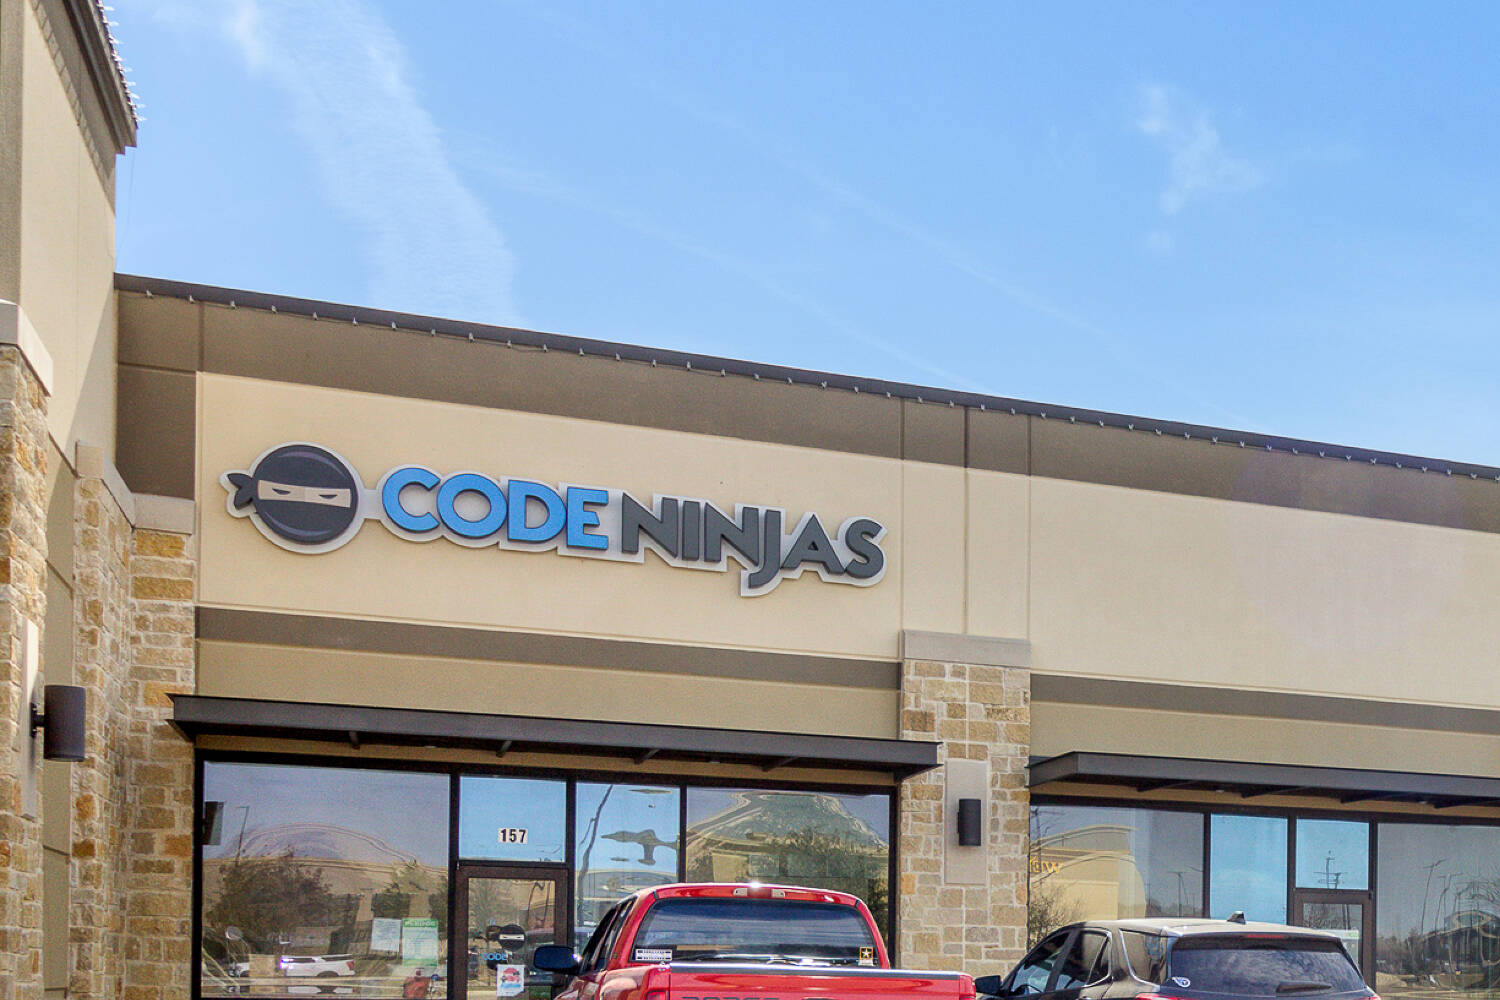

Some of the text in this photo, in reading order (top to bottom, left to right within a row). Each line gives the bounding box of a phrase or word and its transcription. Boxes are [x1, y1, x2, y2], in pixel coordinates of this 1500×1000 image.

[381, 467, 885, 589] CODE NINJAS
[500, 828, 527, 843] 157
